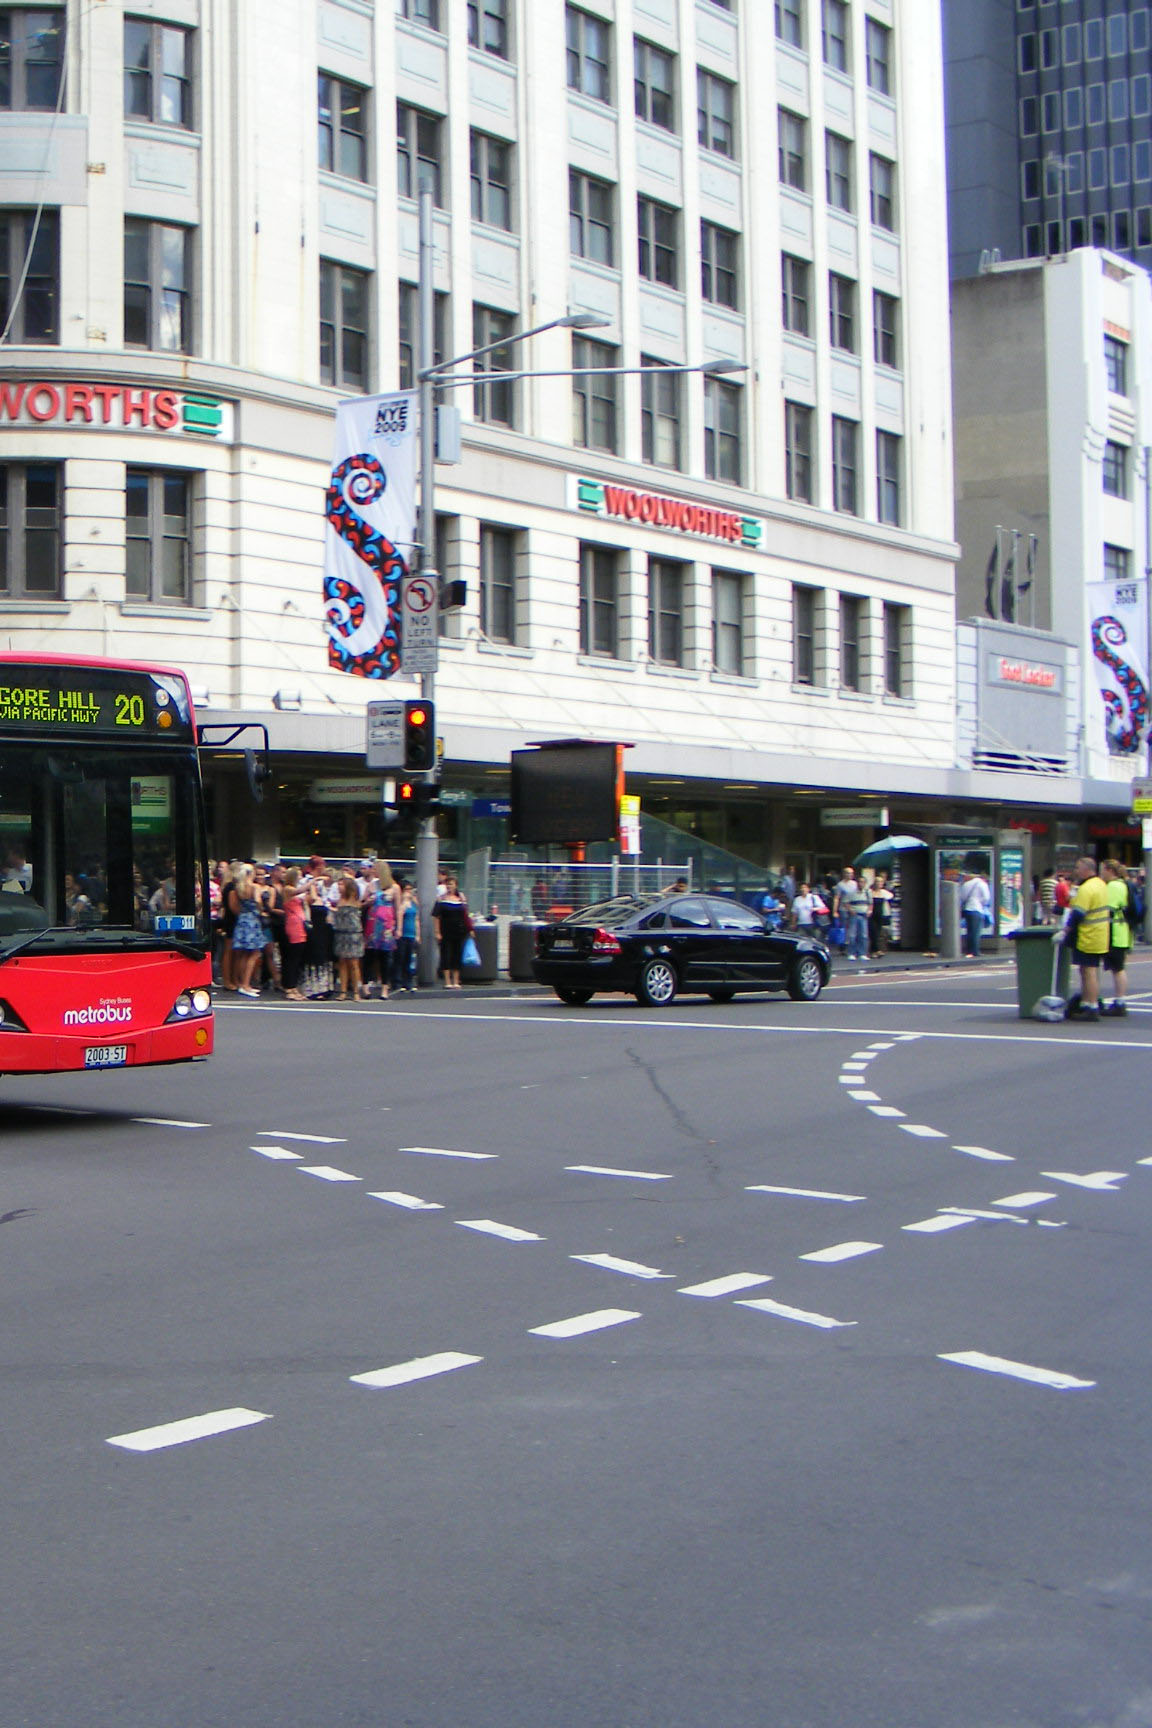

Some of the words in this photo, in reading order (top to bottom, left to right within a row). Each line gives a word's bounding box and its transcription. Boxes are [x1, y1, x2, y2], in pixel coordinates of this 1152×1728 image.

[376, 406, 408, 421] NYE
[375, 421, 407, 433] 2009
[603, 485, 743, 543] WOOLWORTHS
[410, 615, 429, 626] NO
[59, 691, 101, 710] HILL
[23, 707, 68, 721] PACIFIC
[71, 709, 99, 723] HWY
[115, 694, 145, 726] 20
[64, 1005, 132, 1025] metrobus
